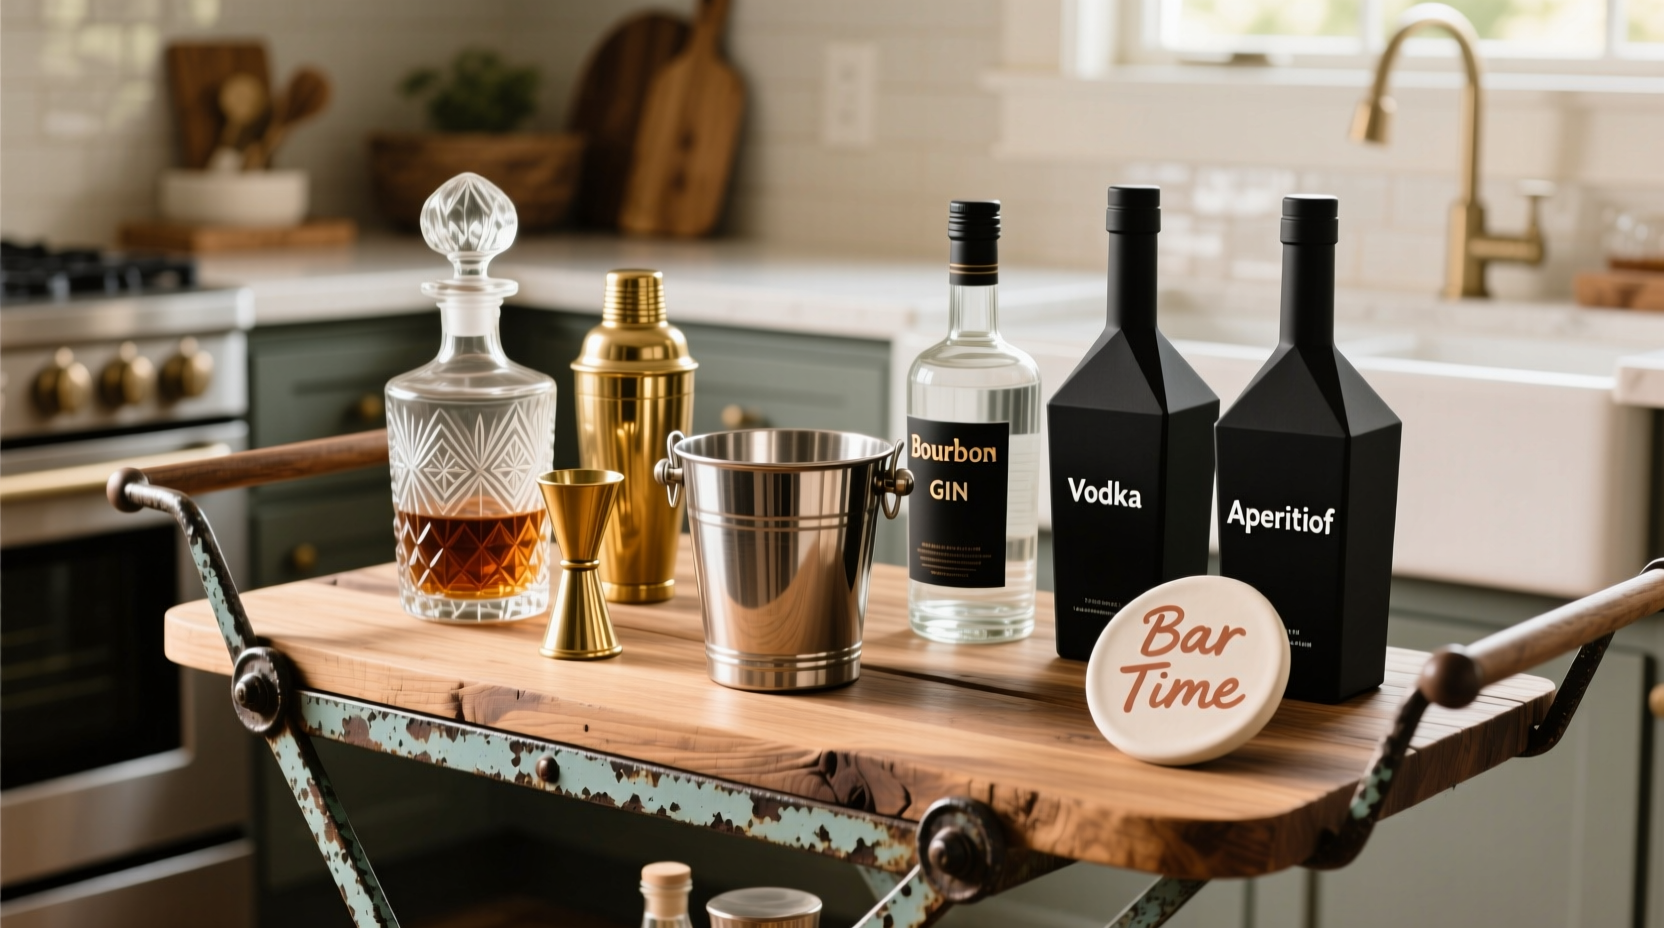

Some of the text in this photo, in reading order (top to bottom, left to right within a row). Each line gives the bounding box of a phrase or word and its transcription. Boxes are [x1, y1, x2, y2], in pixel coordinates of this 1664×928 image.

[911, 433, 997, 463] Bourbon
[929, 479, 968, 502] GIN
[1067, 477, 1142, 509] Vodka
[1226, 499, 1336, 535] Aperitiof
[1140, 604, 1247, 658] Bar
[1119, 661, 1247, 713] Time
